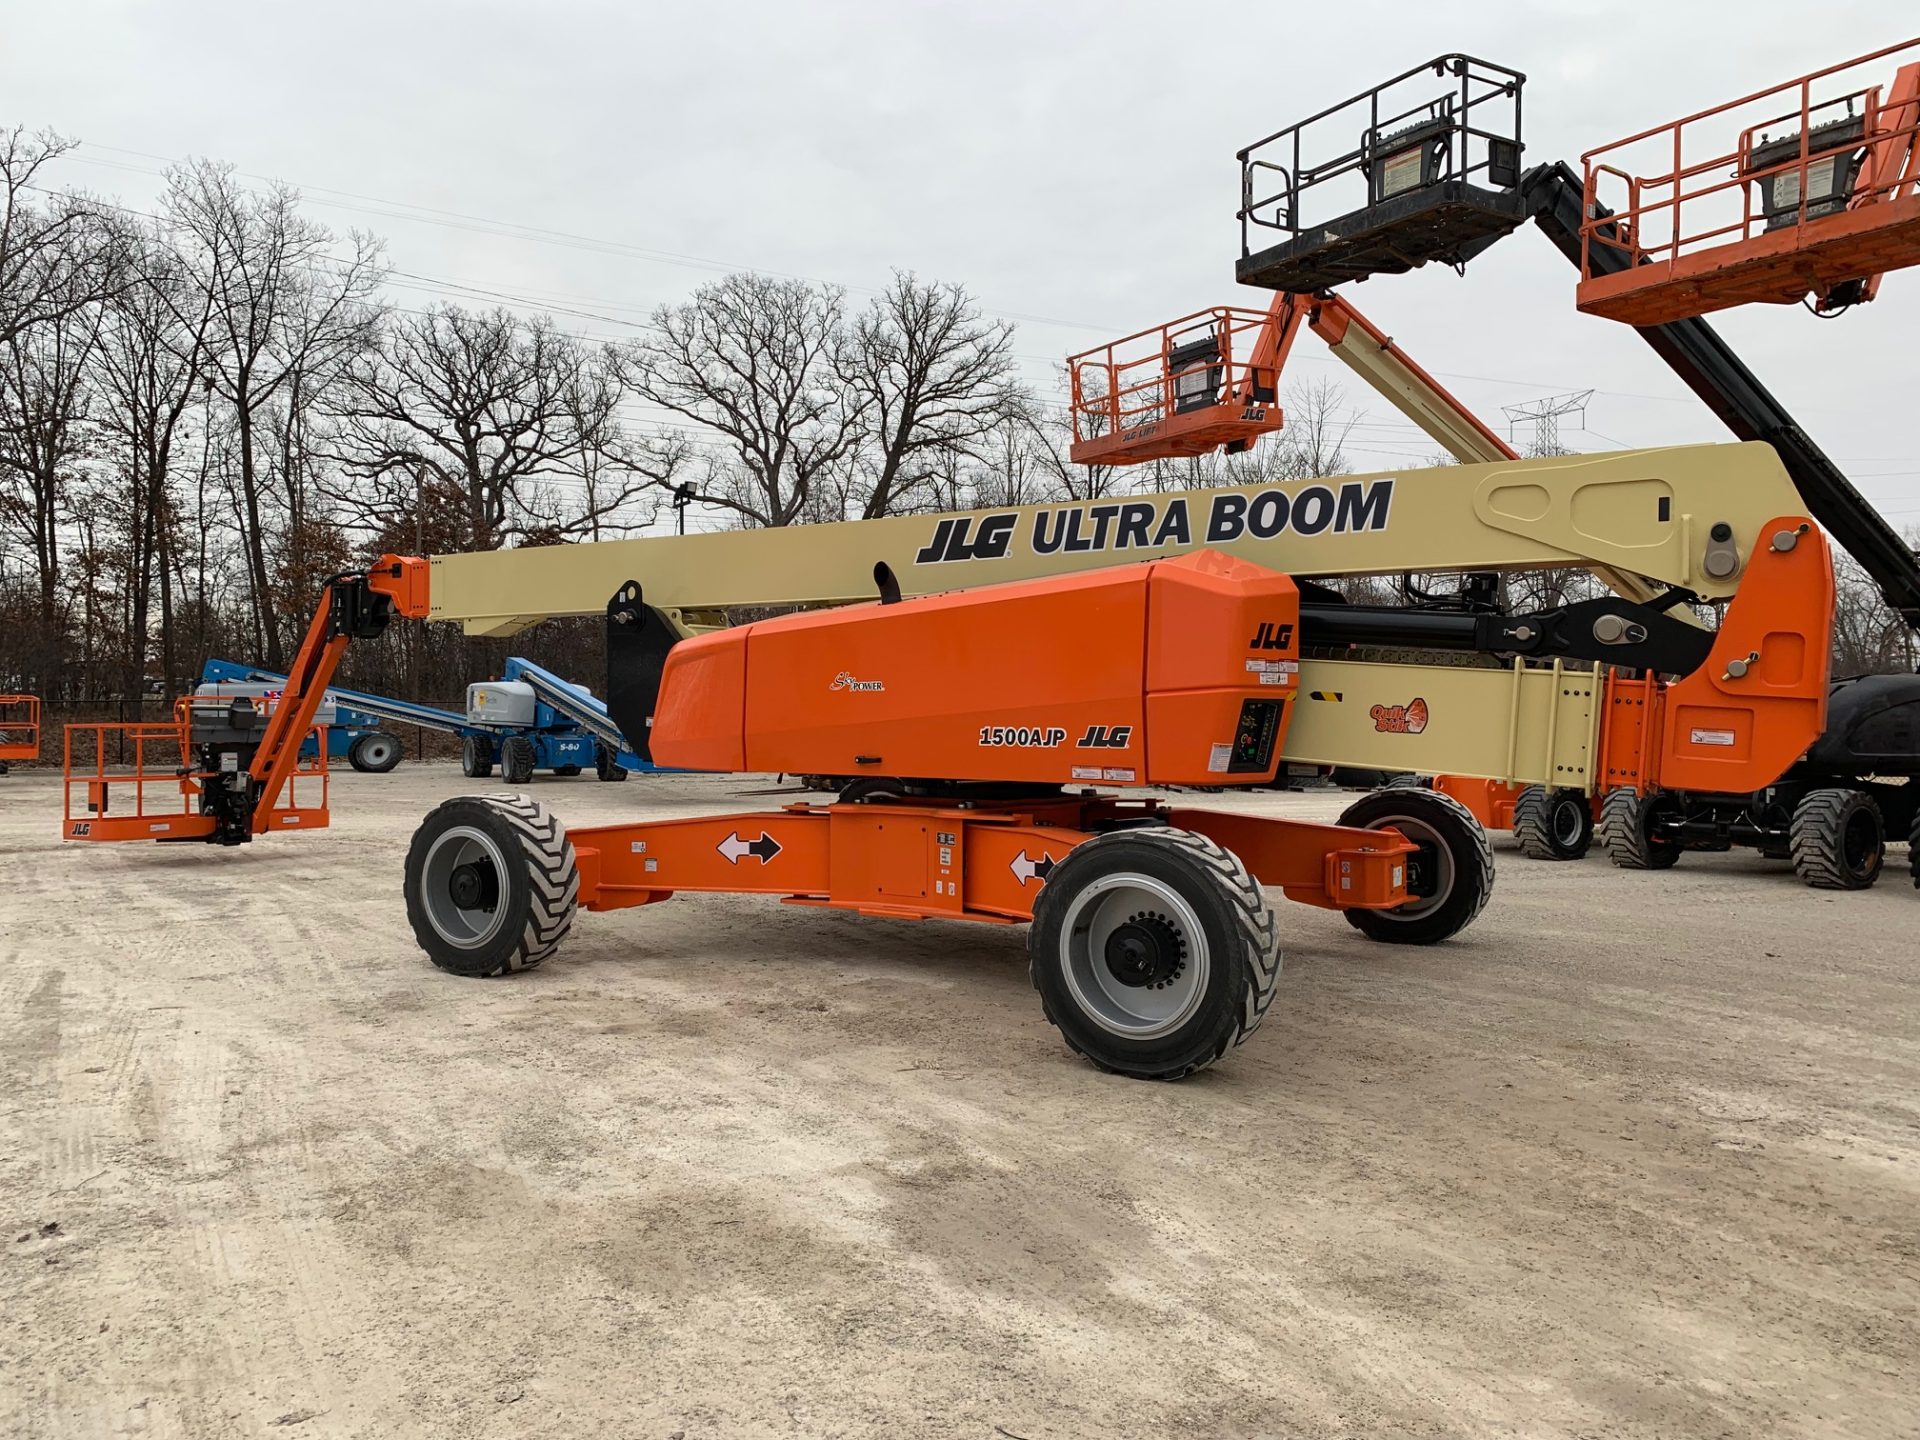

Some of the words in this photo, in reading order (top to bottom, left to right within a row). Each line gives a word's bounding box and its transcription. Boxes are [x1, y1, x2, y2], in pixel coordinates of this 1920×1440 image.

[1240, 408, 1265, 421] JLG
[915, 512, 1020, 565] JLG
[1032, 498, 1193, 555] ULTRA
[1204, 478, 1397, 544] BOOM
[1249, 622, 1294, 650] JLG
[979, 726, 1067, 748] 1500AJP
[1076, 725, 1133, 749] JLG
[71, 823, 90, 836] JLG
